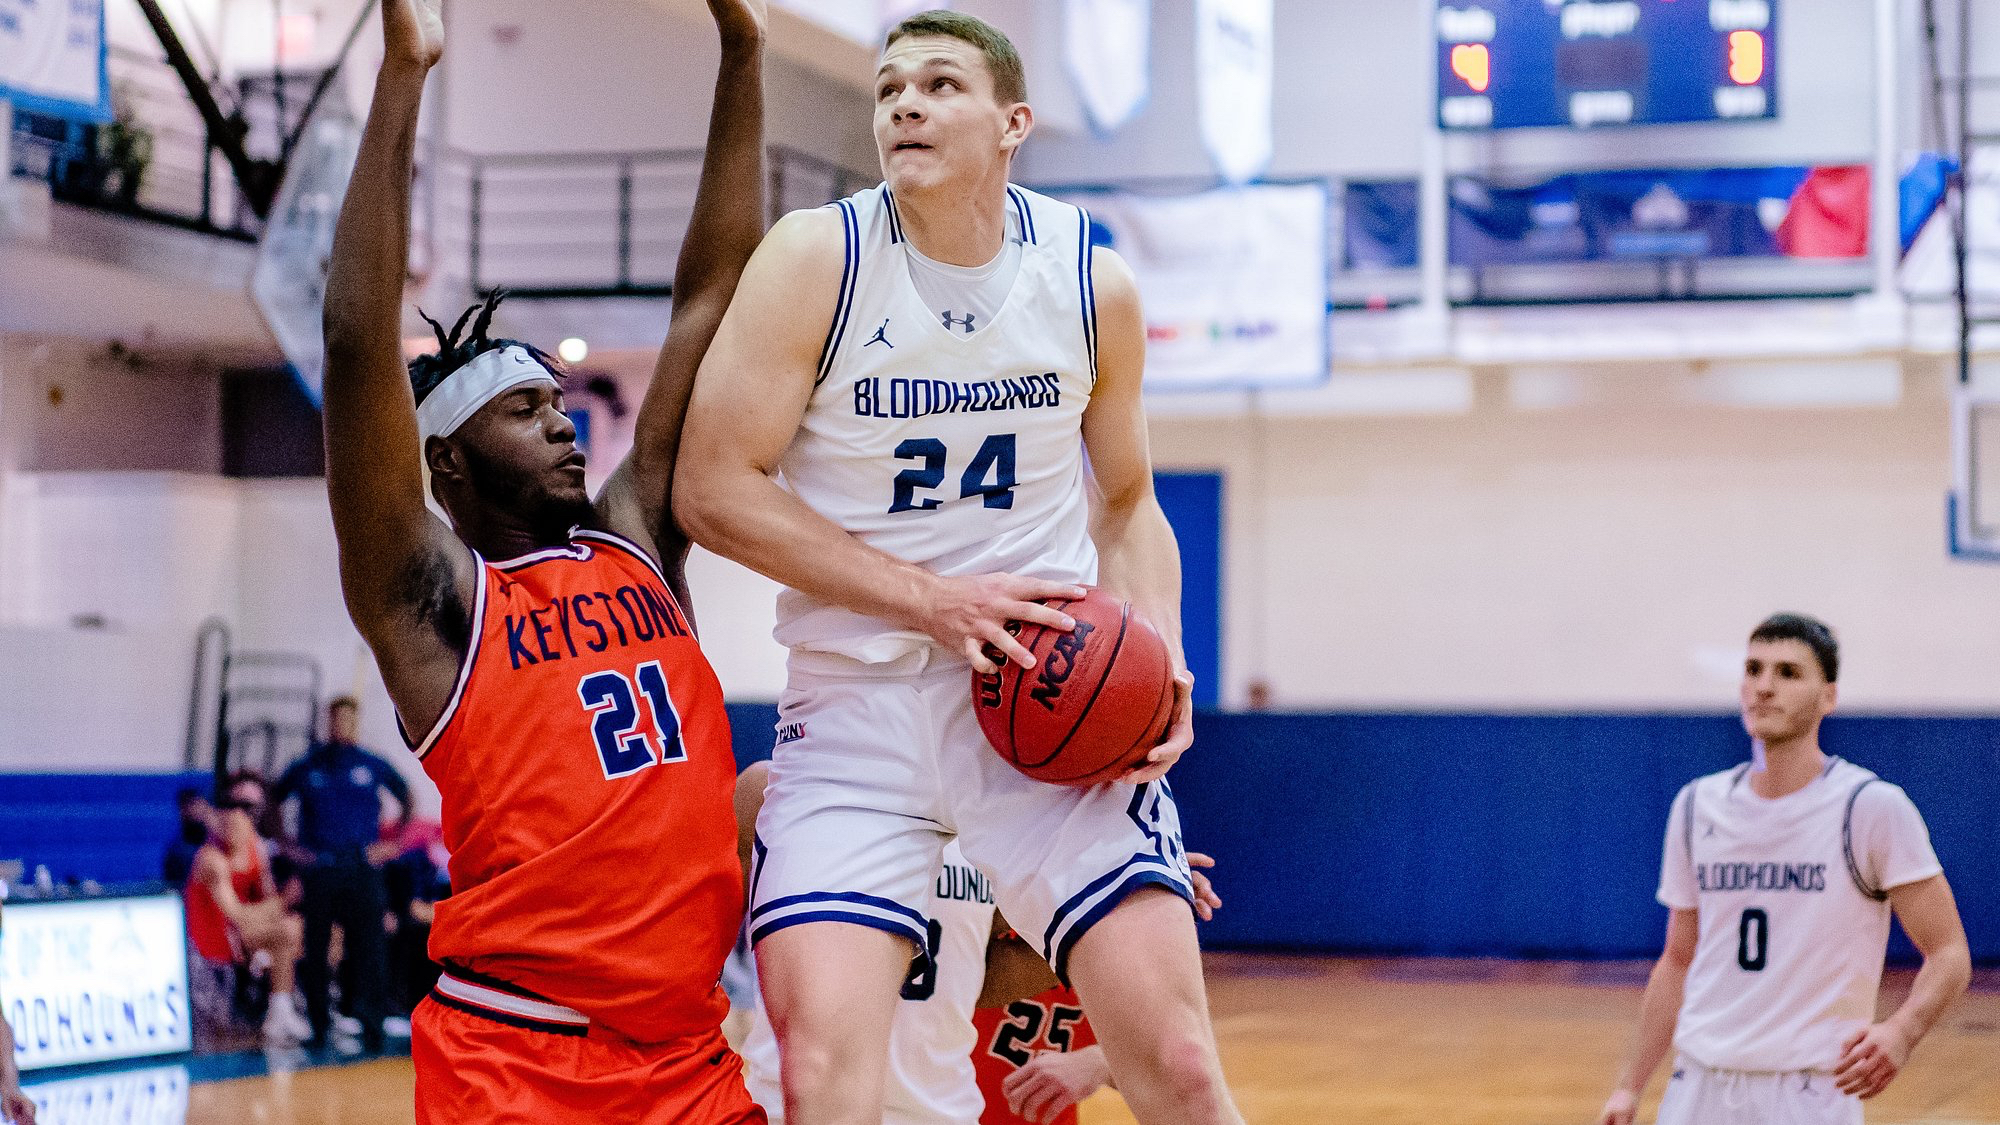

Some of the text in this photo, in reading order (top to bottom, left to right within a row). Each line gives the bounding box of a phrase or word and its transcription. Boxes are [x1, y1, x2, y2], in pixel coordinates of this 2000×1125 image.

[853, 372, 1061, 419] BLOODHOUNDS
[887, 433, 1020, 514] 24
[1029, 618, 1096, 711] NCAA
[576, 659, 688, 780] 21
[936, 864, 993, 905] OUND
[1738, 907, 1768, 972] 0
[987, 998, 1087, 1068] 25
